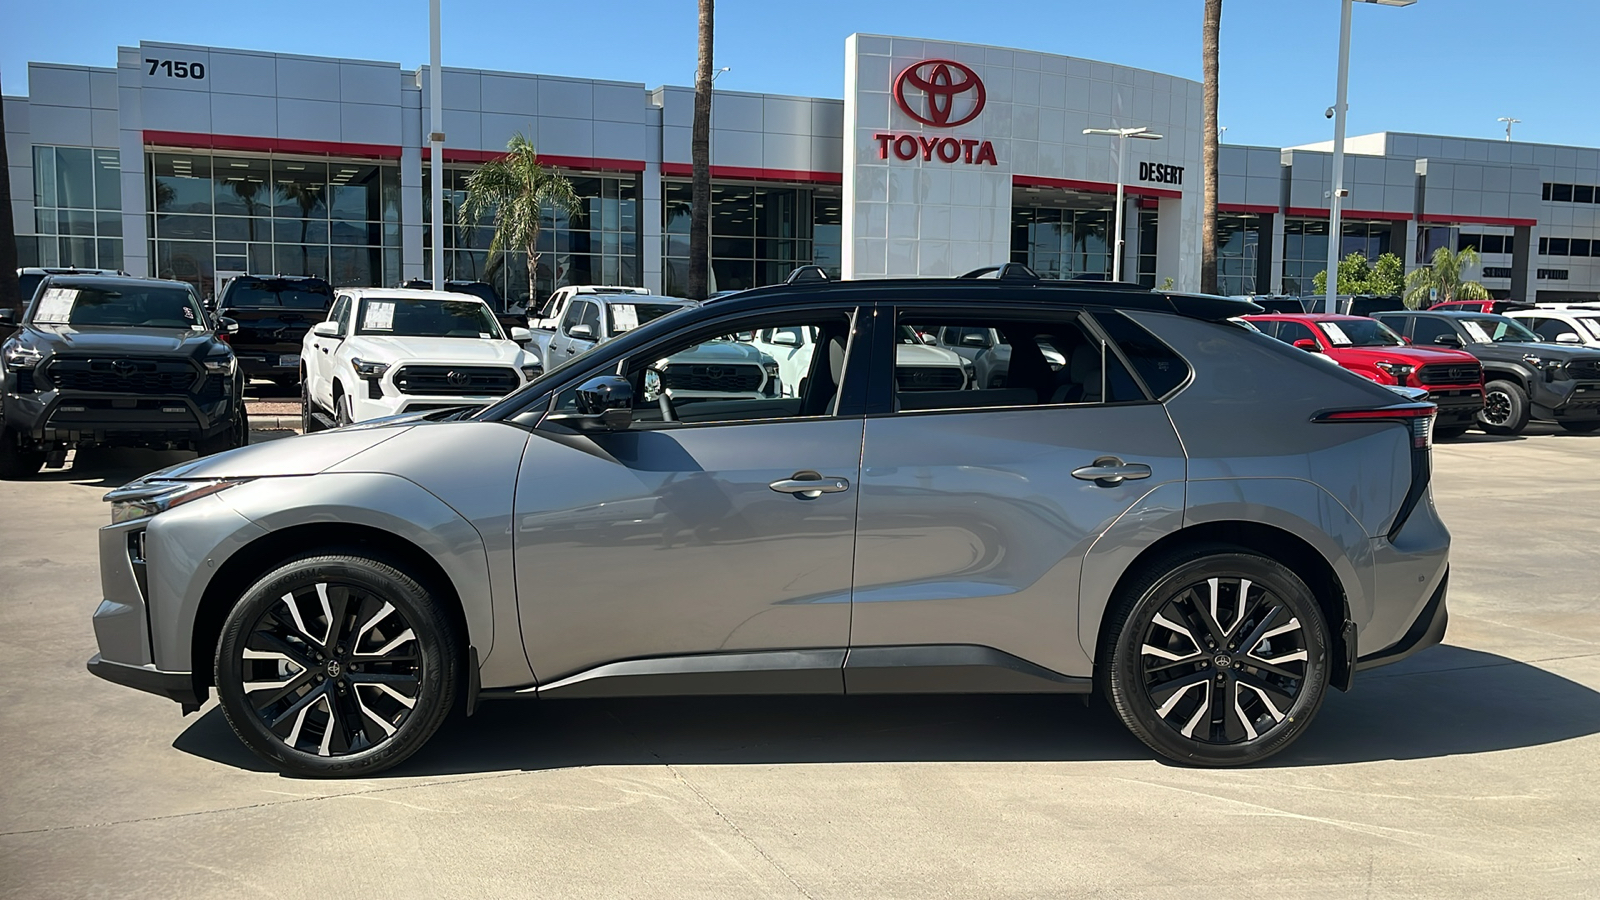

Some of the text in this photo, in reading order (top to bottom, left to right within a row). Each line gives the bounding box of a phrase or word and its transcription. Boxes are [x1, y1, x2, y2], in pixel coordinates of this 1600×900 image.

[145, 58, 205, 80] 7150
[874, 133, 998, 166] TOYOTA
[1139, 161, 1184, 185] DESERT
[1482, 266, 1512, 278] SERVI
[266, 567, 324, 593] YOKOHAMA
